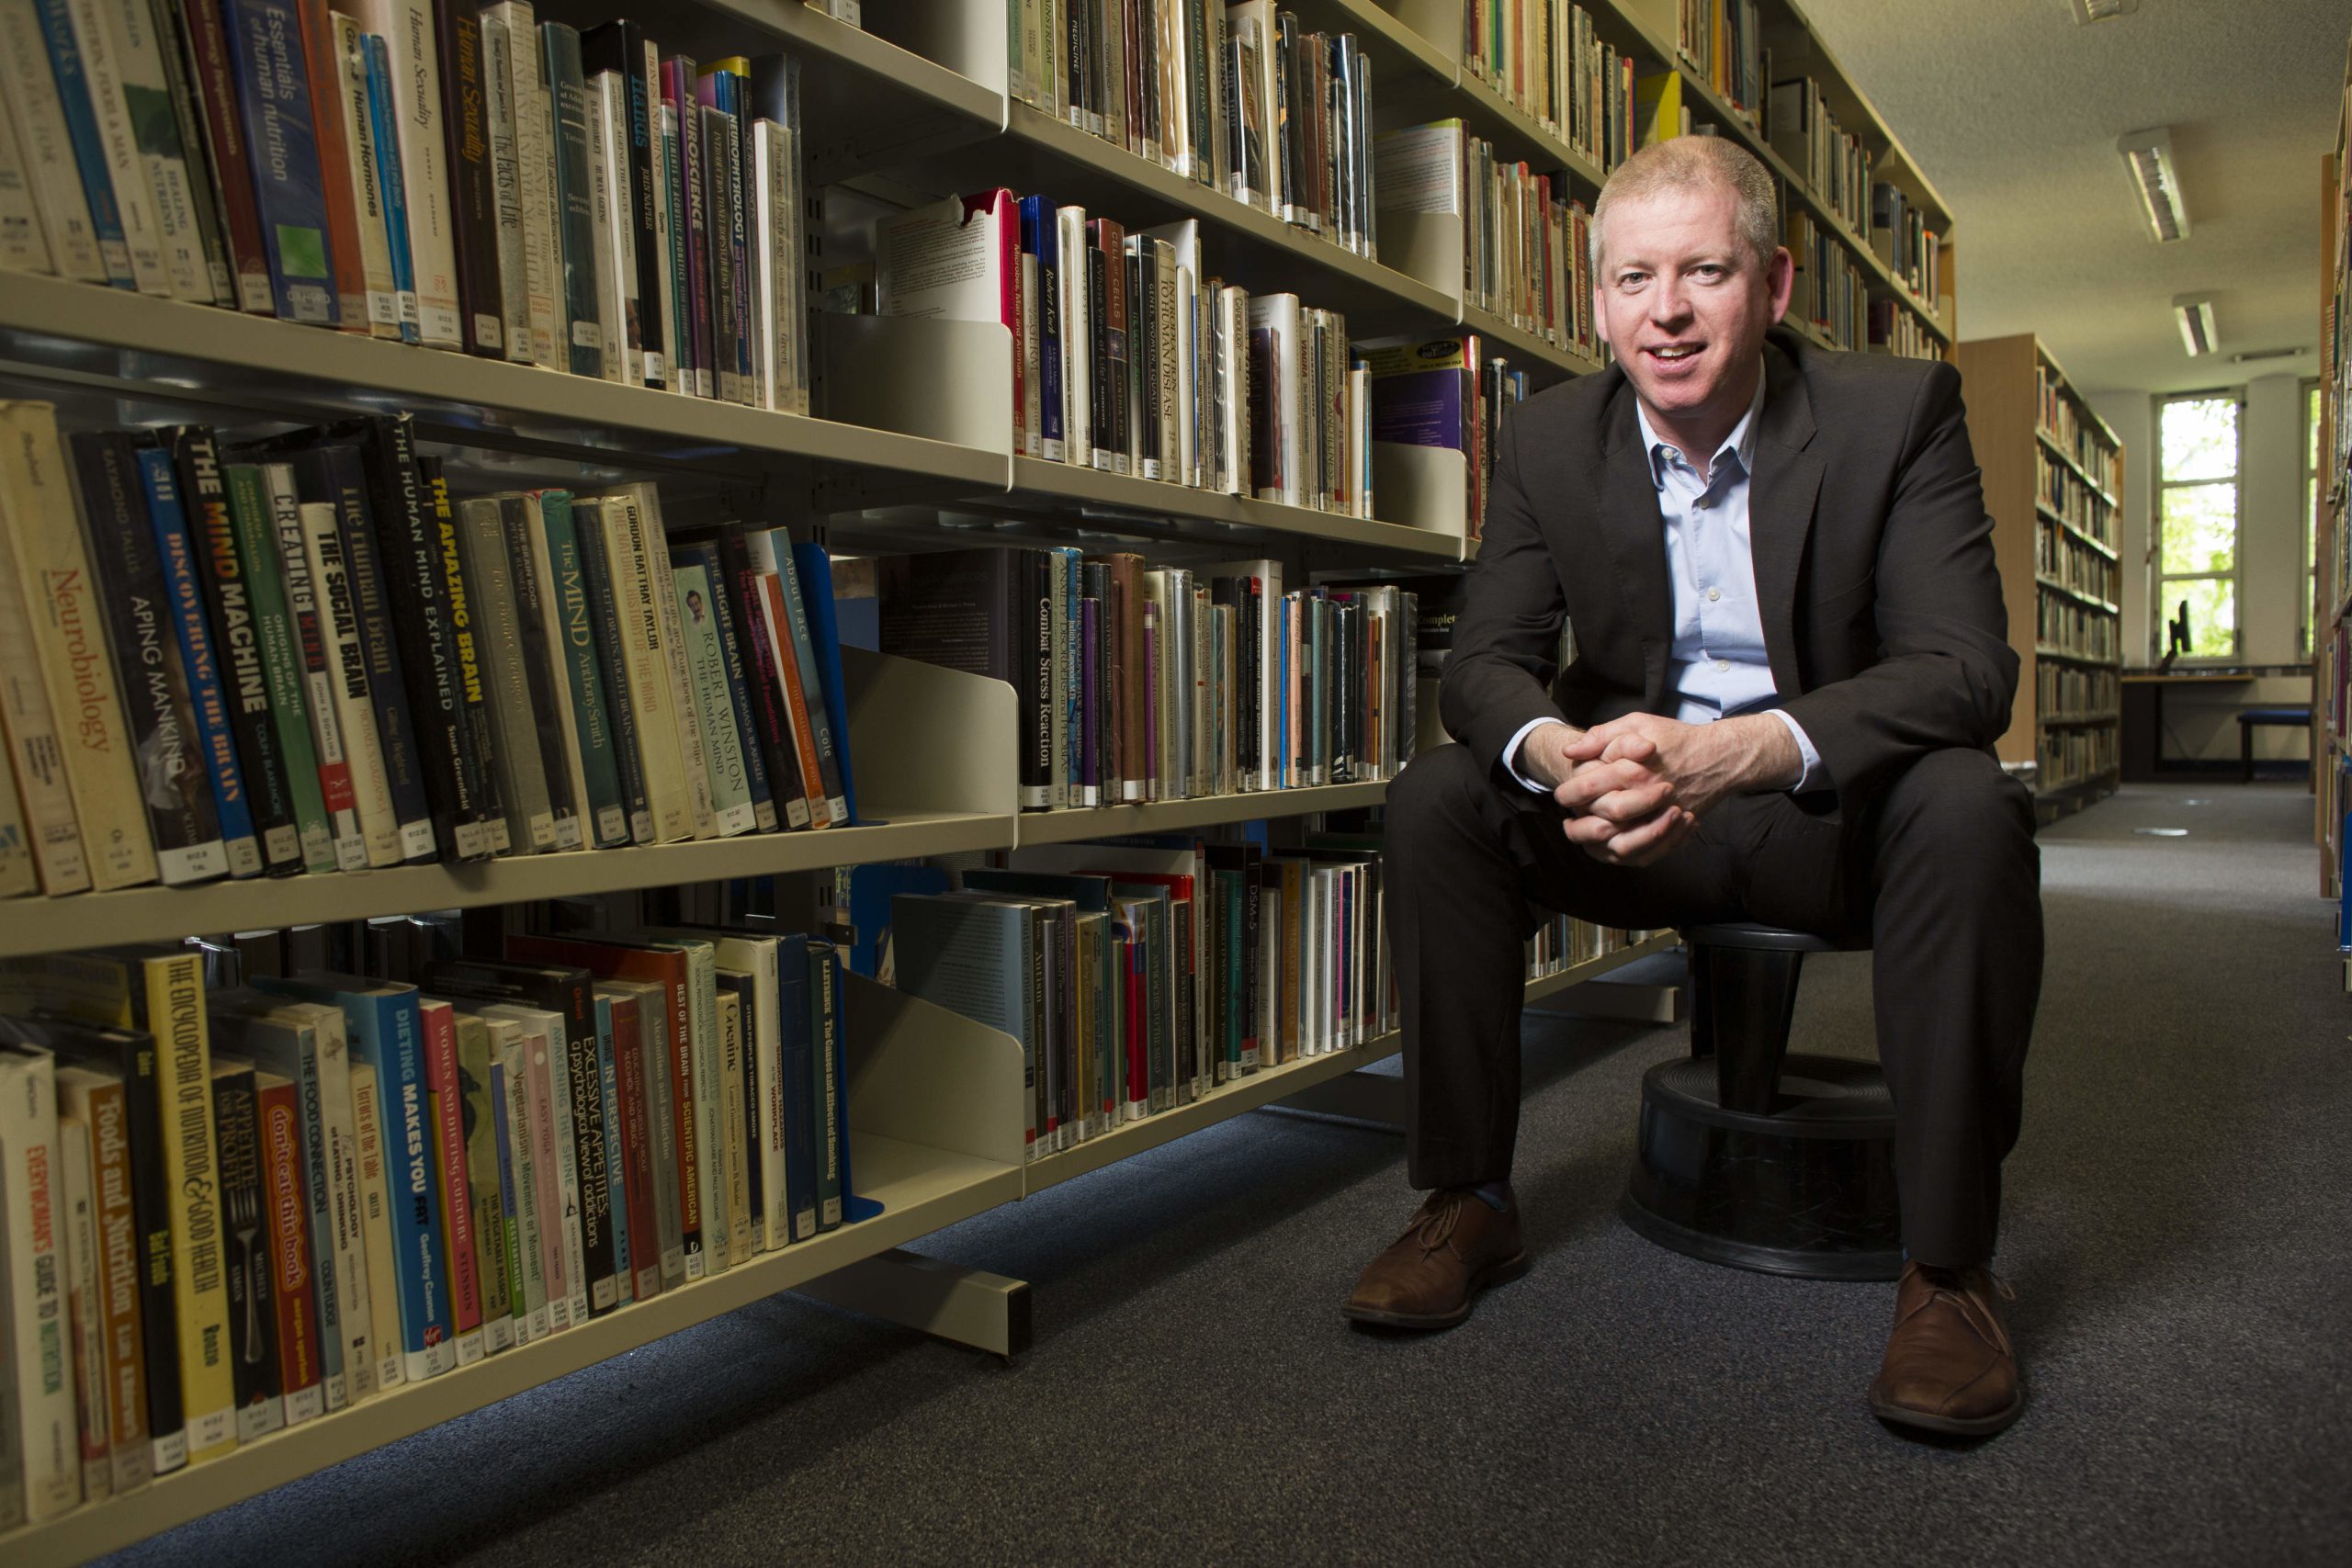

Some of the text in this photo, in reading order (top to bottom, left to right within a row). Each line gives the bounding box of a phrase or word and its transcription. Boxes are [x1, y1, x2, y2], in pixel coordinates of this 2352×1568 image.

[254, 34, 275, 98] human
[266, 6, 295, 99] Essentials
[410, 6, 430, 130] Human Sexuality
[1195, 17, 1201, 31] OF
[1218, 17, 1228, 121] DRUGS SOCIETY
[354, 90, 367, 141] Human
[457, 17, 484, 162] Human Sexuality
[631, 75, 649, 145] Hands
[264, 104, 287, 180] nutrition
[360, 143, 377, 216] Hormones
[493, 133, 523, 228] The Facts of Life
[685, 93, 702, 229] NEUROSCIENCE
[726, 113, 743, 241] NEUROPHYSIOLOGY
[545, 149, 560, 264] All about adolescence
[594, 164, 605, 223] HUMAN AGEING
[640, 166, 652, 230] JOHN NAPIER
[733, 262, 743, 306] biomedical
[1046, 268, 1055, 333] Robert Koch
[780, 332, 788, 364] Green
[1098, 339, 1105, 352] of
[1098, 355, 1106, 381] Life?
[1160, 279, 1171, 422] TO HUMAN DISEASE
[1169, 280, 1179, 393] INTRODUCTION
[432, 477, 450, 517] THE
[191, 439, 266, 712] THE MIND MACHINE
[275, 494, 311, 604] CREATING
[393, 426, 452, 709] THE HUMAN MIND EXPLAINED
[439, 523, 468, 626] AMAZING
[561, 540, 589, 646] The MIND
[315, 529, 367, 701] THE SOCIAL BRAIN
[708, 555, 741, 679] THE RIGHT BRAIN
[785, 557, 807, 640] About Face
[1419, 614, 1455, 626] omplet
[51, 570, 107, 750] Neurobiology
[130, 596, 185, 776] APING MANKIND
[169, 533, 238, 800] DISCOVERING THE BRAIN
[263, 615, 287, 705] HUMAN BRAIN
[276, 614, 301, 716] ORIGINS OF THE
[458, 632, 481, 701] BRAIN
[579, 653, 605, 748] Anthony Smith
[1040, 598, 1051, 766] Combat Stress Reaction
[1057, 559, 1069, 775] ANXIETY DISORDERS and PHOBIAS
[696, 660, 724, 773] THE HUMAN MIND
[703, 632, 742, 791] ROBERT WINSTON
[447, 725, 469, 809] Susan Greenfield
[1249, 885, 1257, 930] DSM-5
[676, 983, 685, 1007] BEST
[678, 1010, 685, 1021] OF
[679, 1025, 687, 1043] THE
[726, 1003, 738, 1070] Cocaine
[1153, 1008, 1160, 1024] TO
[1153, 1022, 1161, 1045] THE
[680, 1045, 688, 1076] BRAIN
[1153, 1047, 1161, 1073] MIND
[98, 1100, 124, 1164] Foods
[168, 958, 219, 1292] THE ENCYCLOPEDIA OF NUTRITION & GOOD HEALTH
[233, 1089, 256, 1187] APPETITE
[302, 1052, 326, 1213] THE FOOD CONNECTION
[396, 1009, 429, 1224] DIETING MAKES YOU FAT
[570, 1041, 597, 1247] a psychological view of addictions
[582, 1036, 608, 1216] EXCESSIVE APPETITES:
[683, 1101, 693, 1161] SCIENTIFIC
[102, 1167, 129, 1208] and
[272, 1109, 302, 1287] don't eat this book
[686, 1166, 696, 1224] AMERICAN
[106, 1213, 133, 1313] Nutrition
[420, 1233, 434, 1321] Geoffrey Cannon
